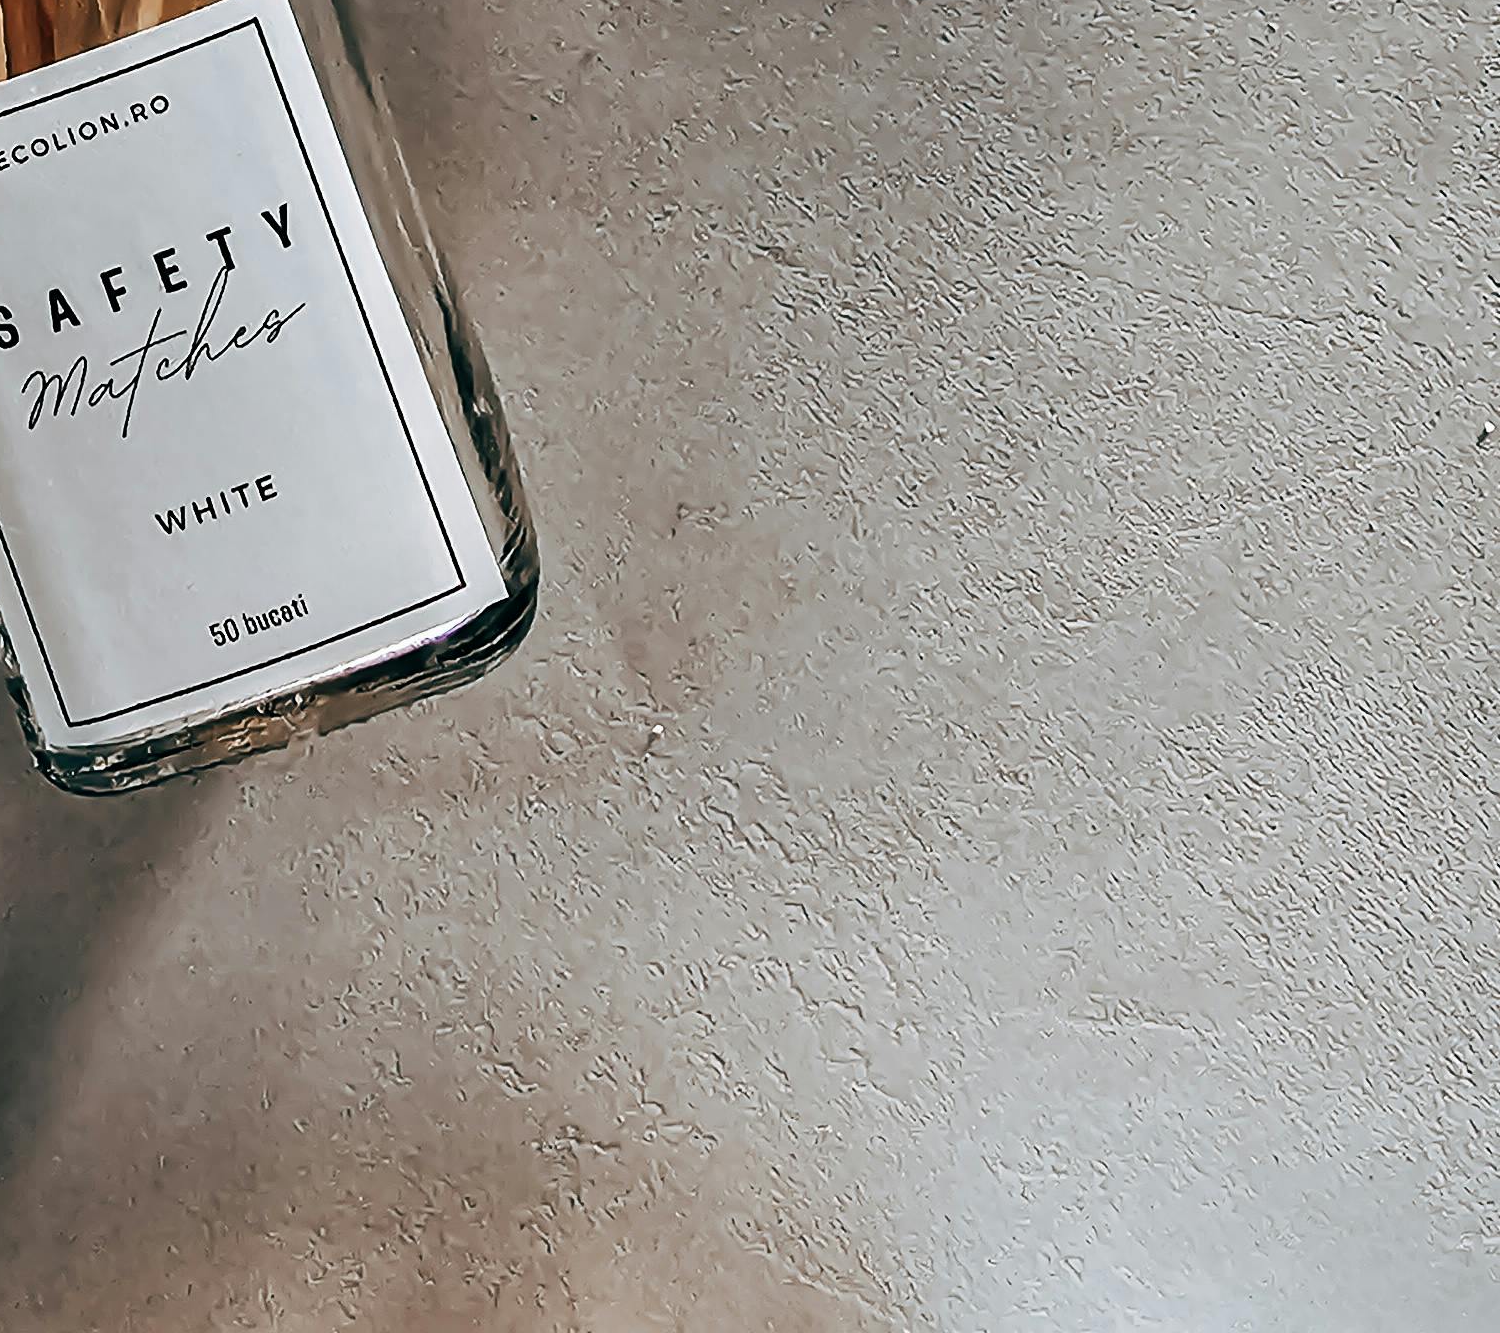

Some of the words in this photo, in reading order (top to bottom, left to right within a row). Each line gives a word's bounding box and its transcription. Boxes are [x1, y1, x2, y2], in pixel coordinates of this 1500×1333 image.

[22, 266, 305, 436] Matches
[156, 474, 279, 536] WHITE
[210, 619, 239, 648] 50
[243, 594, 309, 637] bucati
